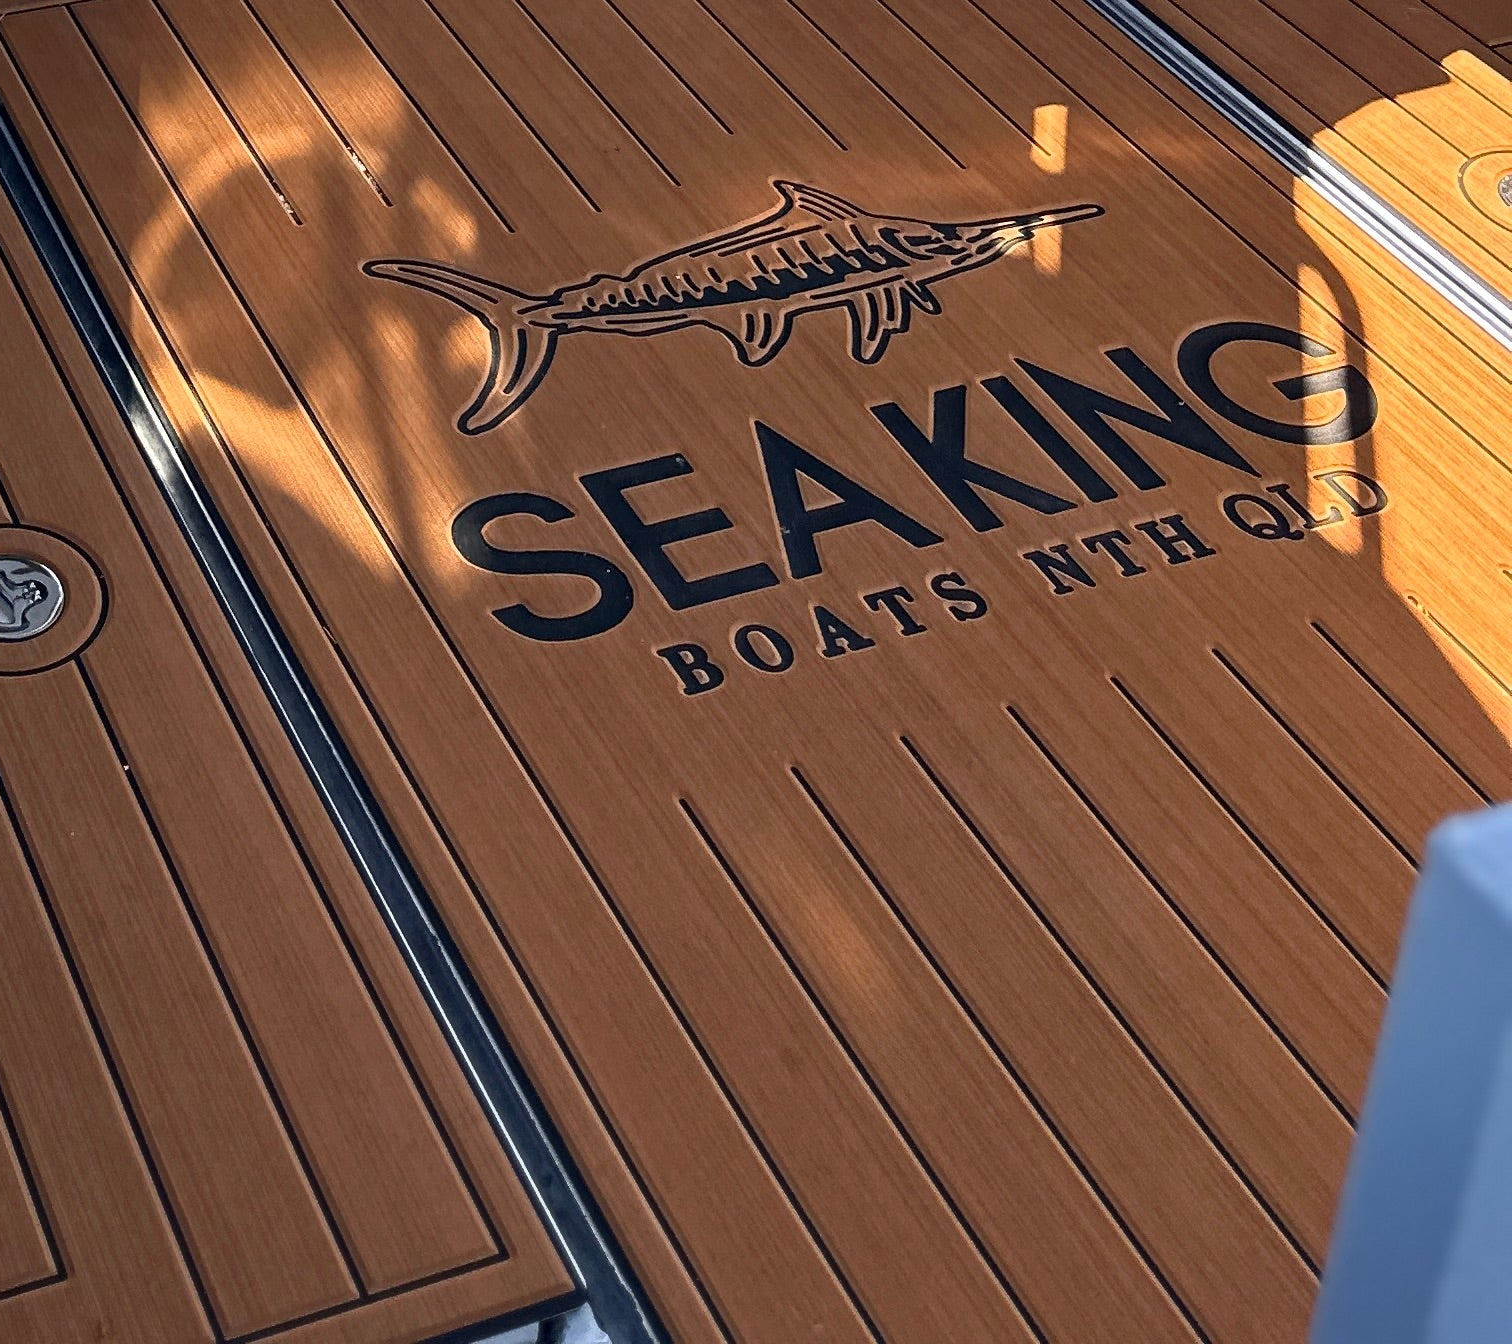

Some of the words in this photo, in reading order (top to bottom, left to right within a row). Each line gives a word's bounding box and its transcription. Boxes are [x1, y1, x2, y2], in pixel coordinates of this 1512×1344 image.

[450, 321, 1379, 642] SEAKING
[656, 571, 988, 696] BOATS
[1023, 514, 1217, 595] NTH
[1222, 470, 1388, 541] QLD
